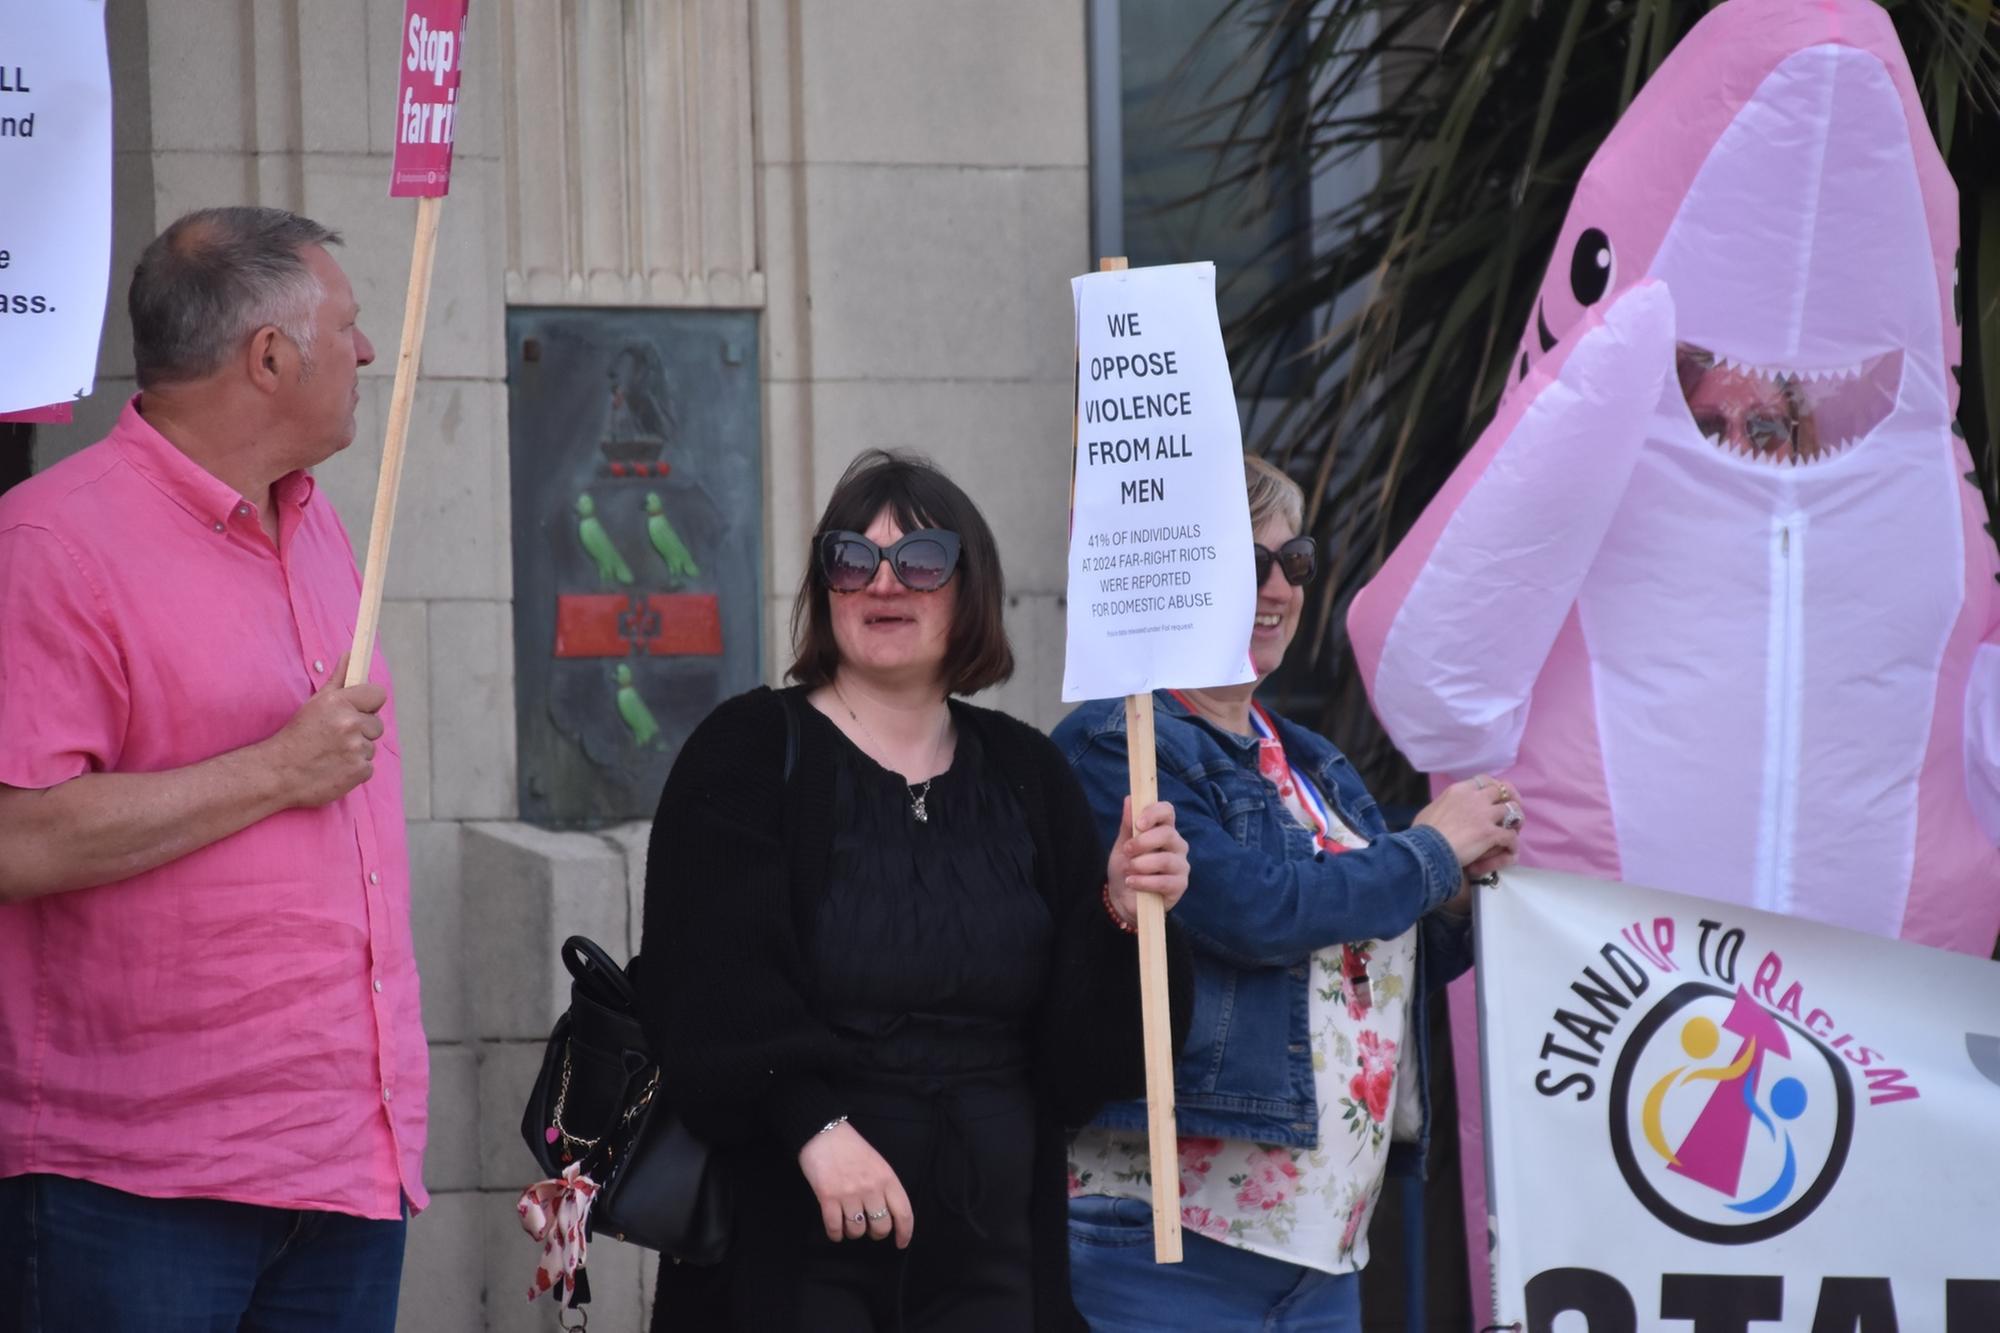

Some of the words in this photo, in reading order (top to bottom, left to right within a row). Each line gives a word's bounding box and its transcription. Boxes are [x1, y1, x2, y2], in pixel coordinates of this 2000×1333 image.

[406, 13, 454, 86] Stop
[401, 86, 431, 144] far
[1107, 313, 1142, 338] WE
[1091, 351, 1178, 381] OPPOSE
[1086, 392, 1192, 424] VIOLENCE
[1088, 438, 1150, 466] FROM
[1155, 434, 1192, 460] ALL
[1121, 478, 1165, 505] MEN
[1088, 532, 1111, 548] 41%
[1112, 531, 1128, 546] OF
[1130, 524, 1201, 545] INDIVIDUALS
[1082, 558, 1092, 573] AT
[1093, 556, 1117, 571] 2024
[1119, 549, 1177, 568] FAR-RIGHT
[1180, 546, 1217, 562] RIOTS
[1100, 576, 1129, 592] WERE
[1131, 571, 1191, 590] REPORTED
[1092, 602, 1110, 617] FOR
[1111, 596, 1166, 616] DOMESTIC
[1168, 592, 1213, 609] ABUSE
[1535, 942, 1650, 1102] STAND
[1620, 917, 1680, 973] UP
[1698, 919, 1746, 985] TO
[1753, 951, 1921, 1106] RACISM
